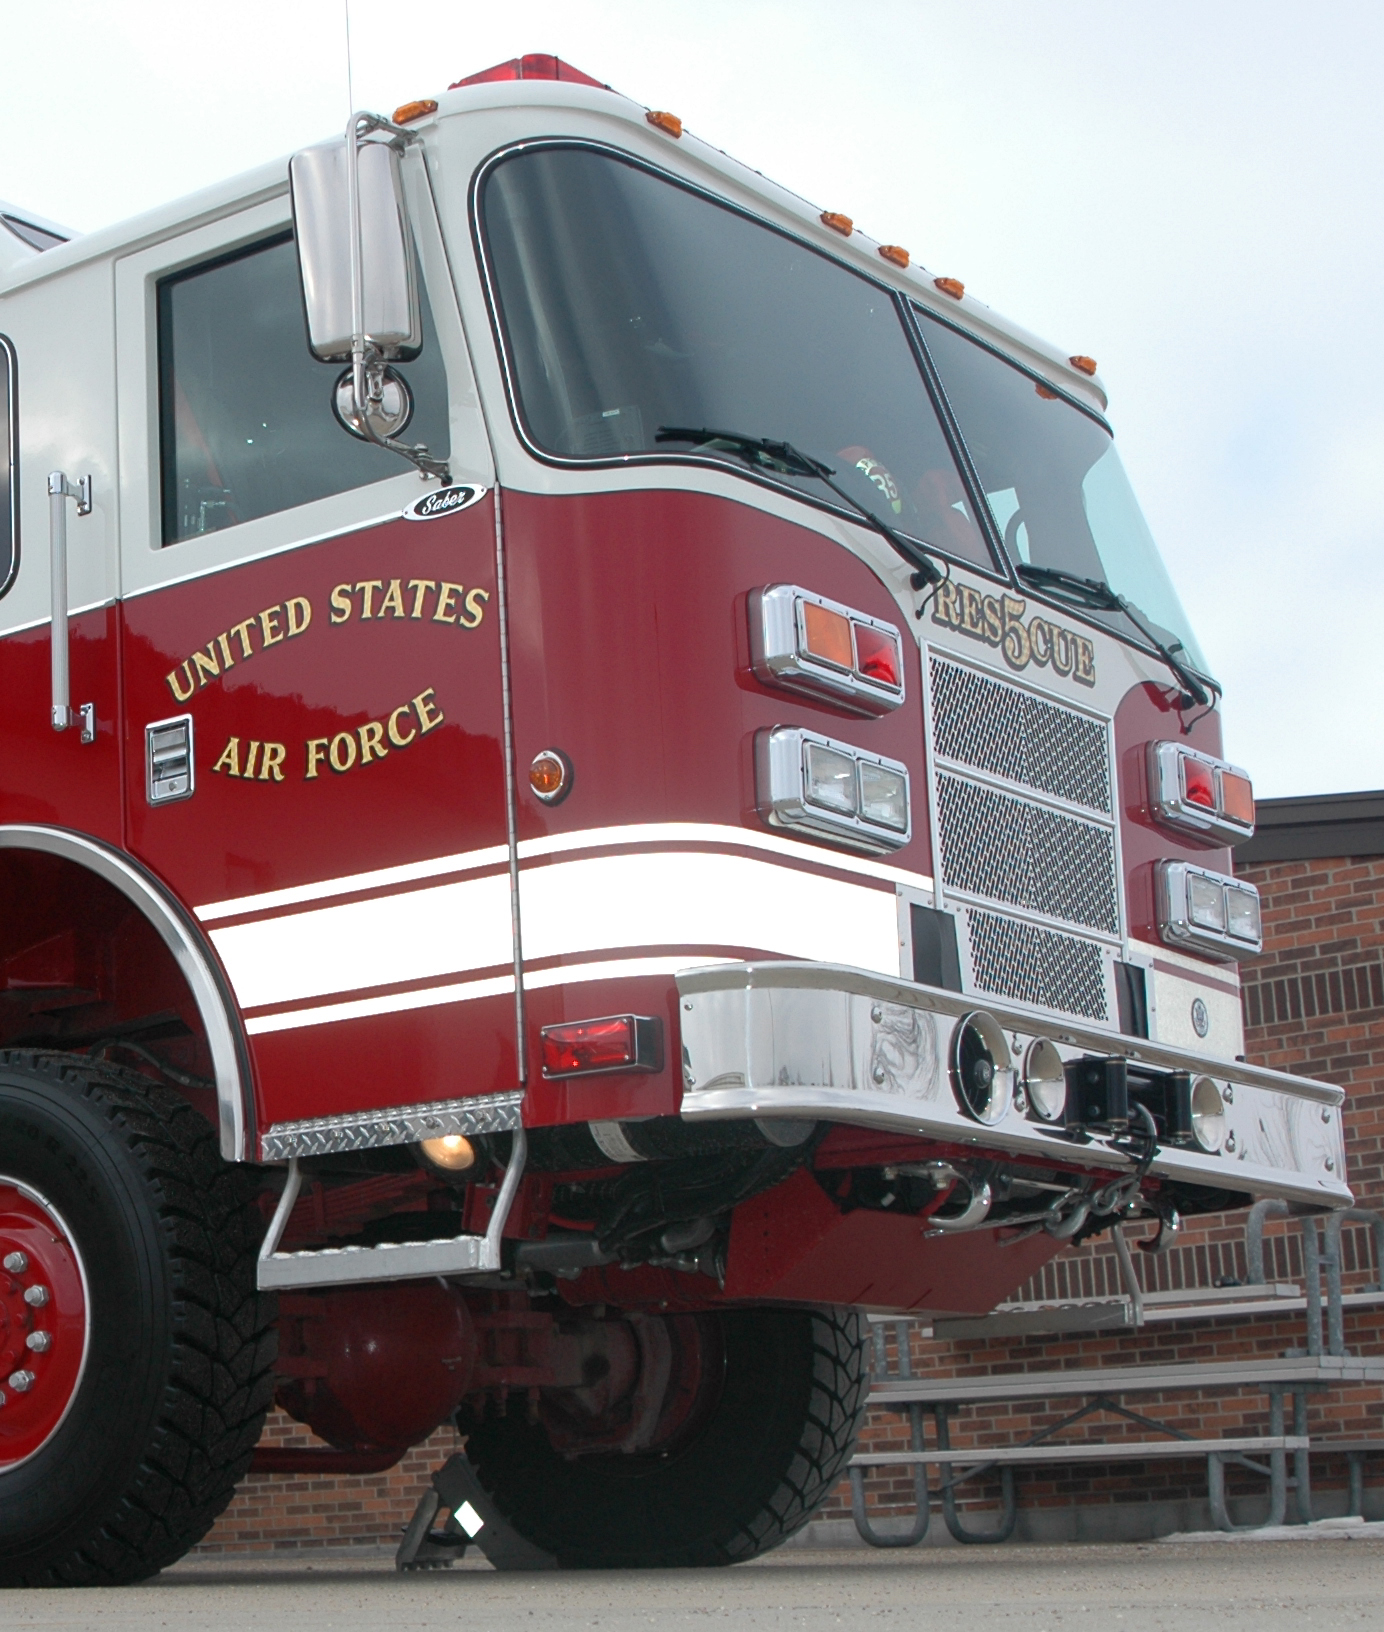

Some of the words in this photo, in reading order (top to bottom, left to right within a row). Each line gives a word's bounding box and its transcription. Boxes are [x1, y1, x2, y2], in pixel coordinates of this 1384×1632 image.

[422, 491, 466, 515] Saber
[165, 596, 312, 703] UNITED
[329, 579, 491, 630] STATES
[212, 736, 287, 782] AIR
[304, 687, 444, 779] FORCE
